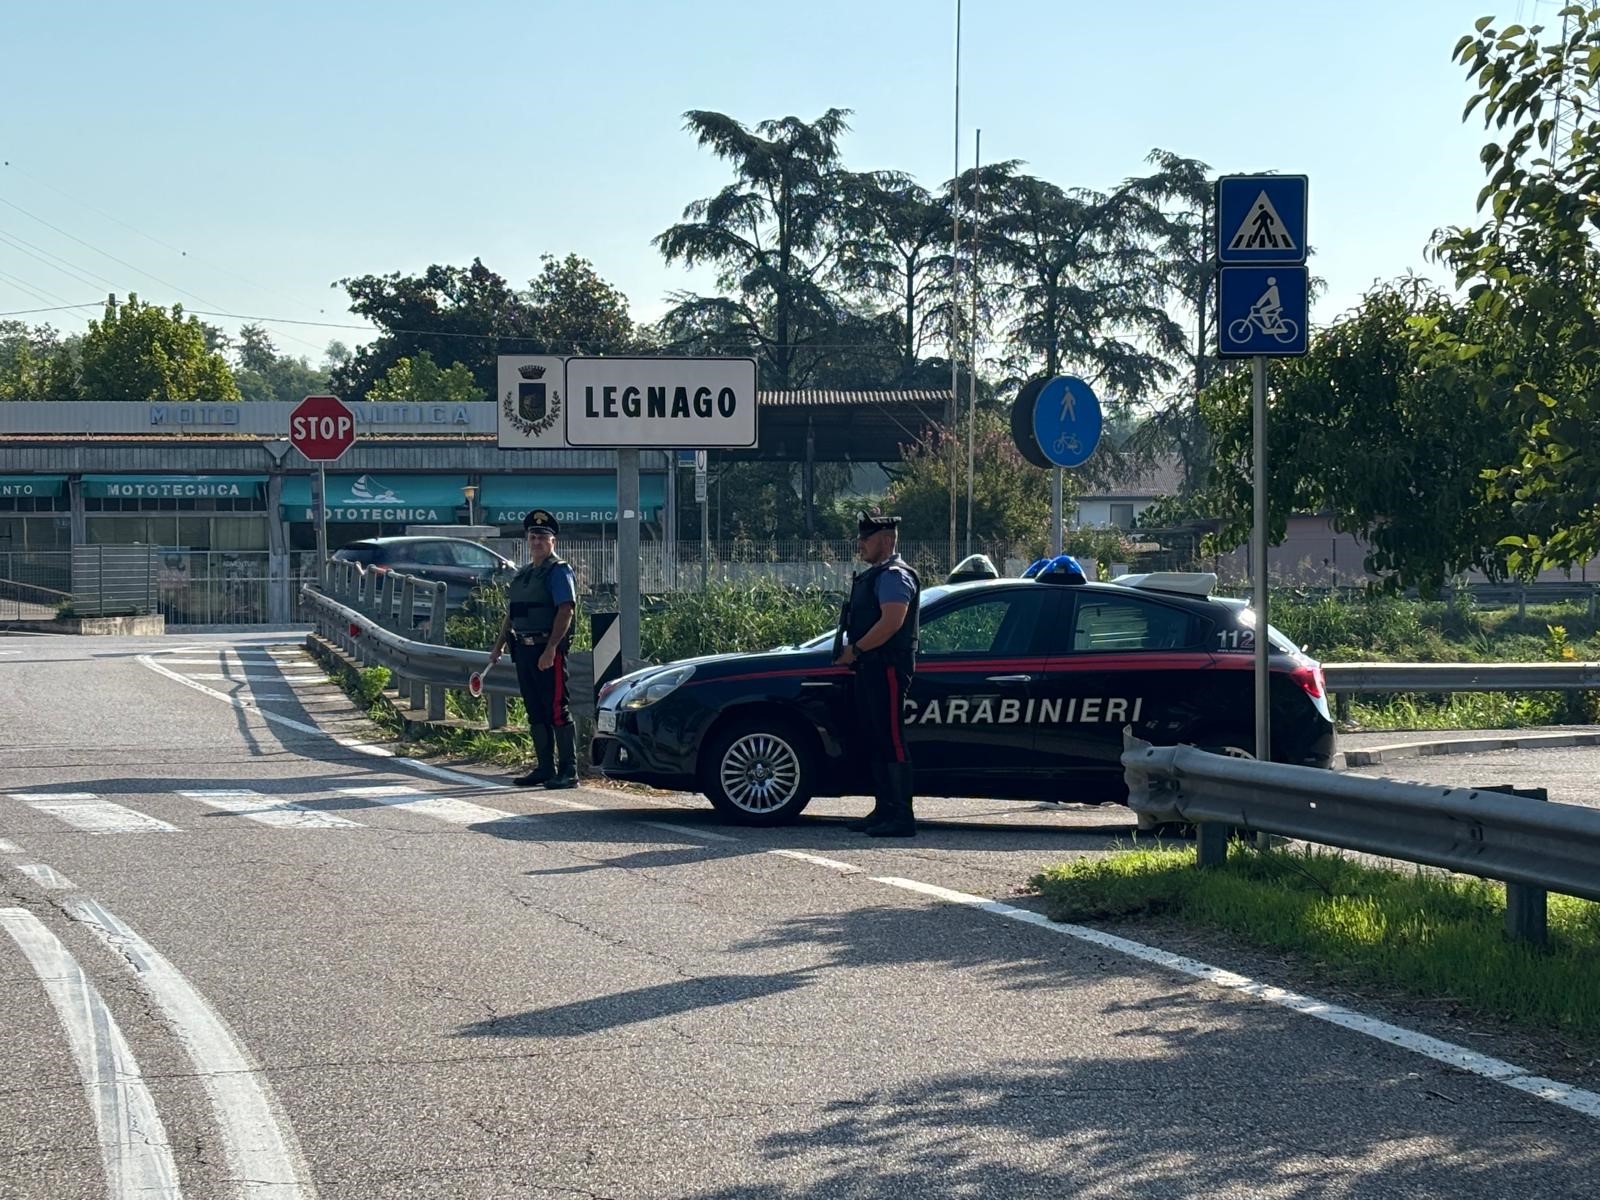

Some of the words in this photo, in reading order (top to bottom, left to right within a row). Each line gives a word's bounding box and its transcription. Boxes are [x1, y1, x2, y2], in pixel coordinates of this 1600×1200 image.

[585, 386, 736, 418] LEGNAGO
[151, 405, 239, 425] MOTO
[354, 405, 470, 424] AUTICA
[293, 416, 351, 440] STOP
[0, 484, 33, 495] NTO
[107, 483, 240, 497] MOTOTECNICA
[1216, 630, 1255, 648] 112
[904, 697, 1143, 725] CARABINIERI
